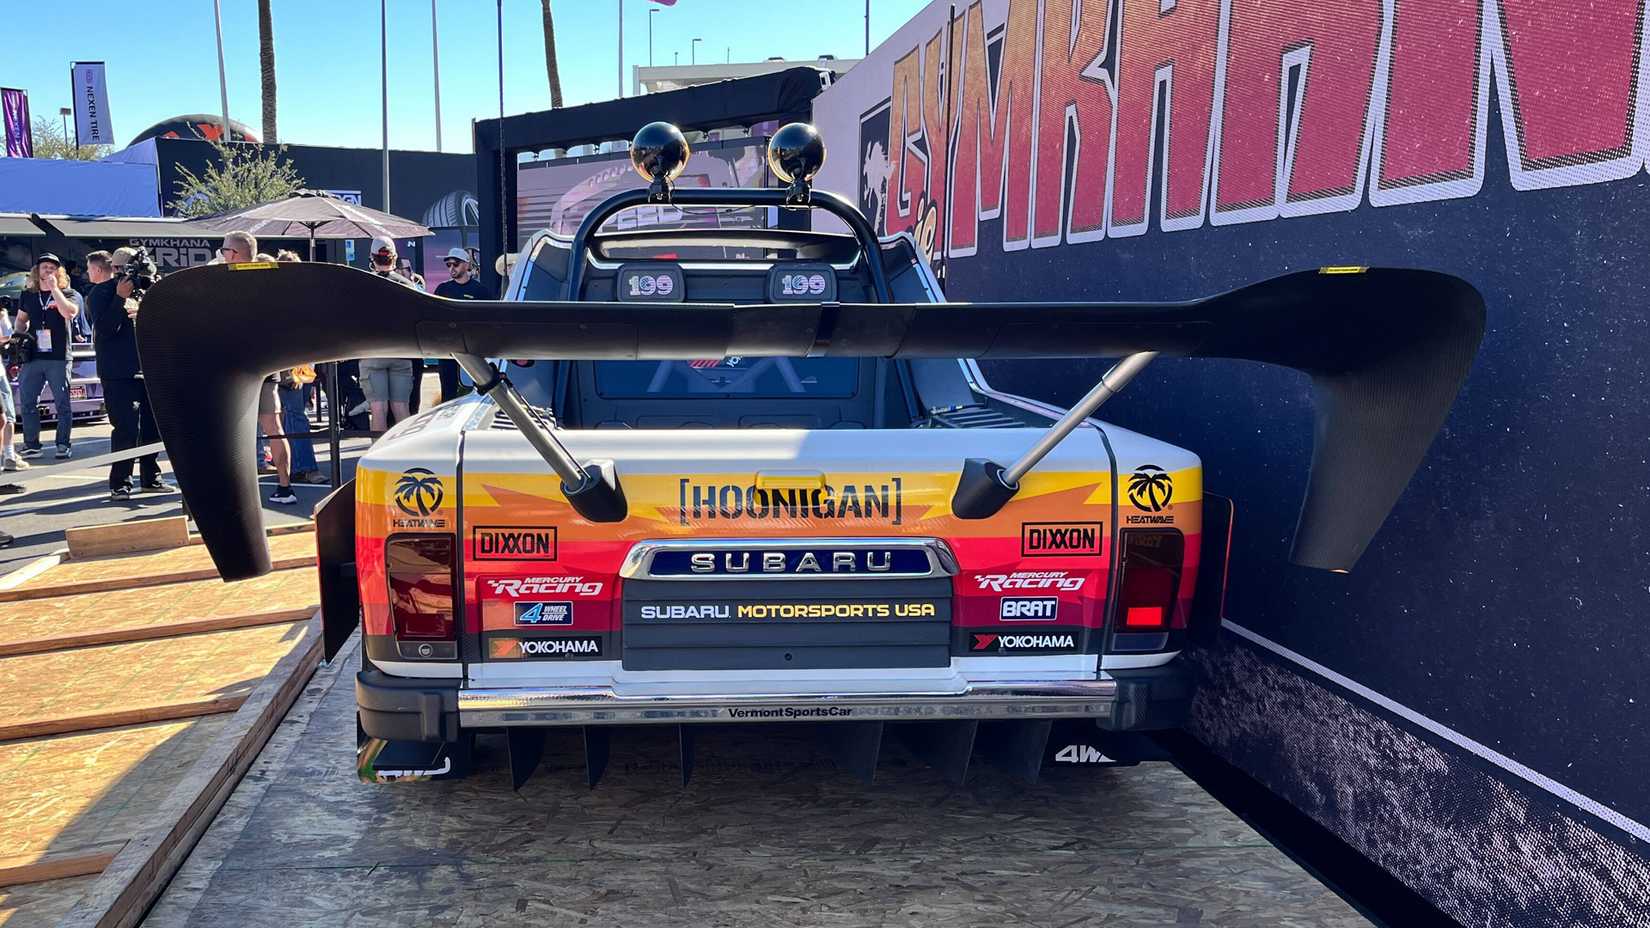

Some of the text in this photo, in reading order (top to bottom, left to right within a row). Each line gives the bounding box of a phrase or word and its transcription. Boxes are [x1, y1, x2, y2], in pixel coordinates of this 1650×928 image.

[86, 86, 100, 141] NEXEN TIRE
[129, 238, 210, 247] GYMKHANA
[630, 275, 673, 296] 199
[782, 275, 826, 296] 199
[392, 519, 446, 528] HEATWAVE
[1126, 515, 1174, 524] HEATWAVE
[480, 532, 549, 554] DIXXON
[1029, 528, 1096, 550] DIXXON
[690, 551, 891, 573] SUBARU
[524, 576, 584, 584] MERCURY
[1010, 571, 1069, 579] MERCURY
[519, 602, 544, 624] 4
[543, 605, 567, 614] WHEEL
[640, 603, 935, 619] SUBARU MOTORSPORTS USA
[1002, 600, 1056, 617] BRAT
[542, 614, 565, 622] DRIVE
[518, 640, 599, 654] YOKOHAMA
[997, 635, 1075, 648] YOKOHAMA
[728, 706, 853, 719] VermontSportsCar
